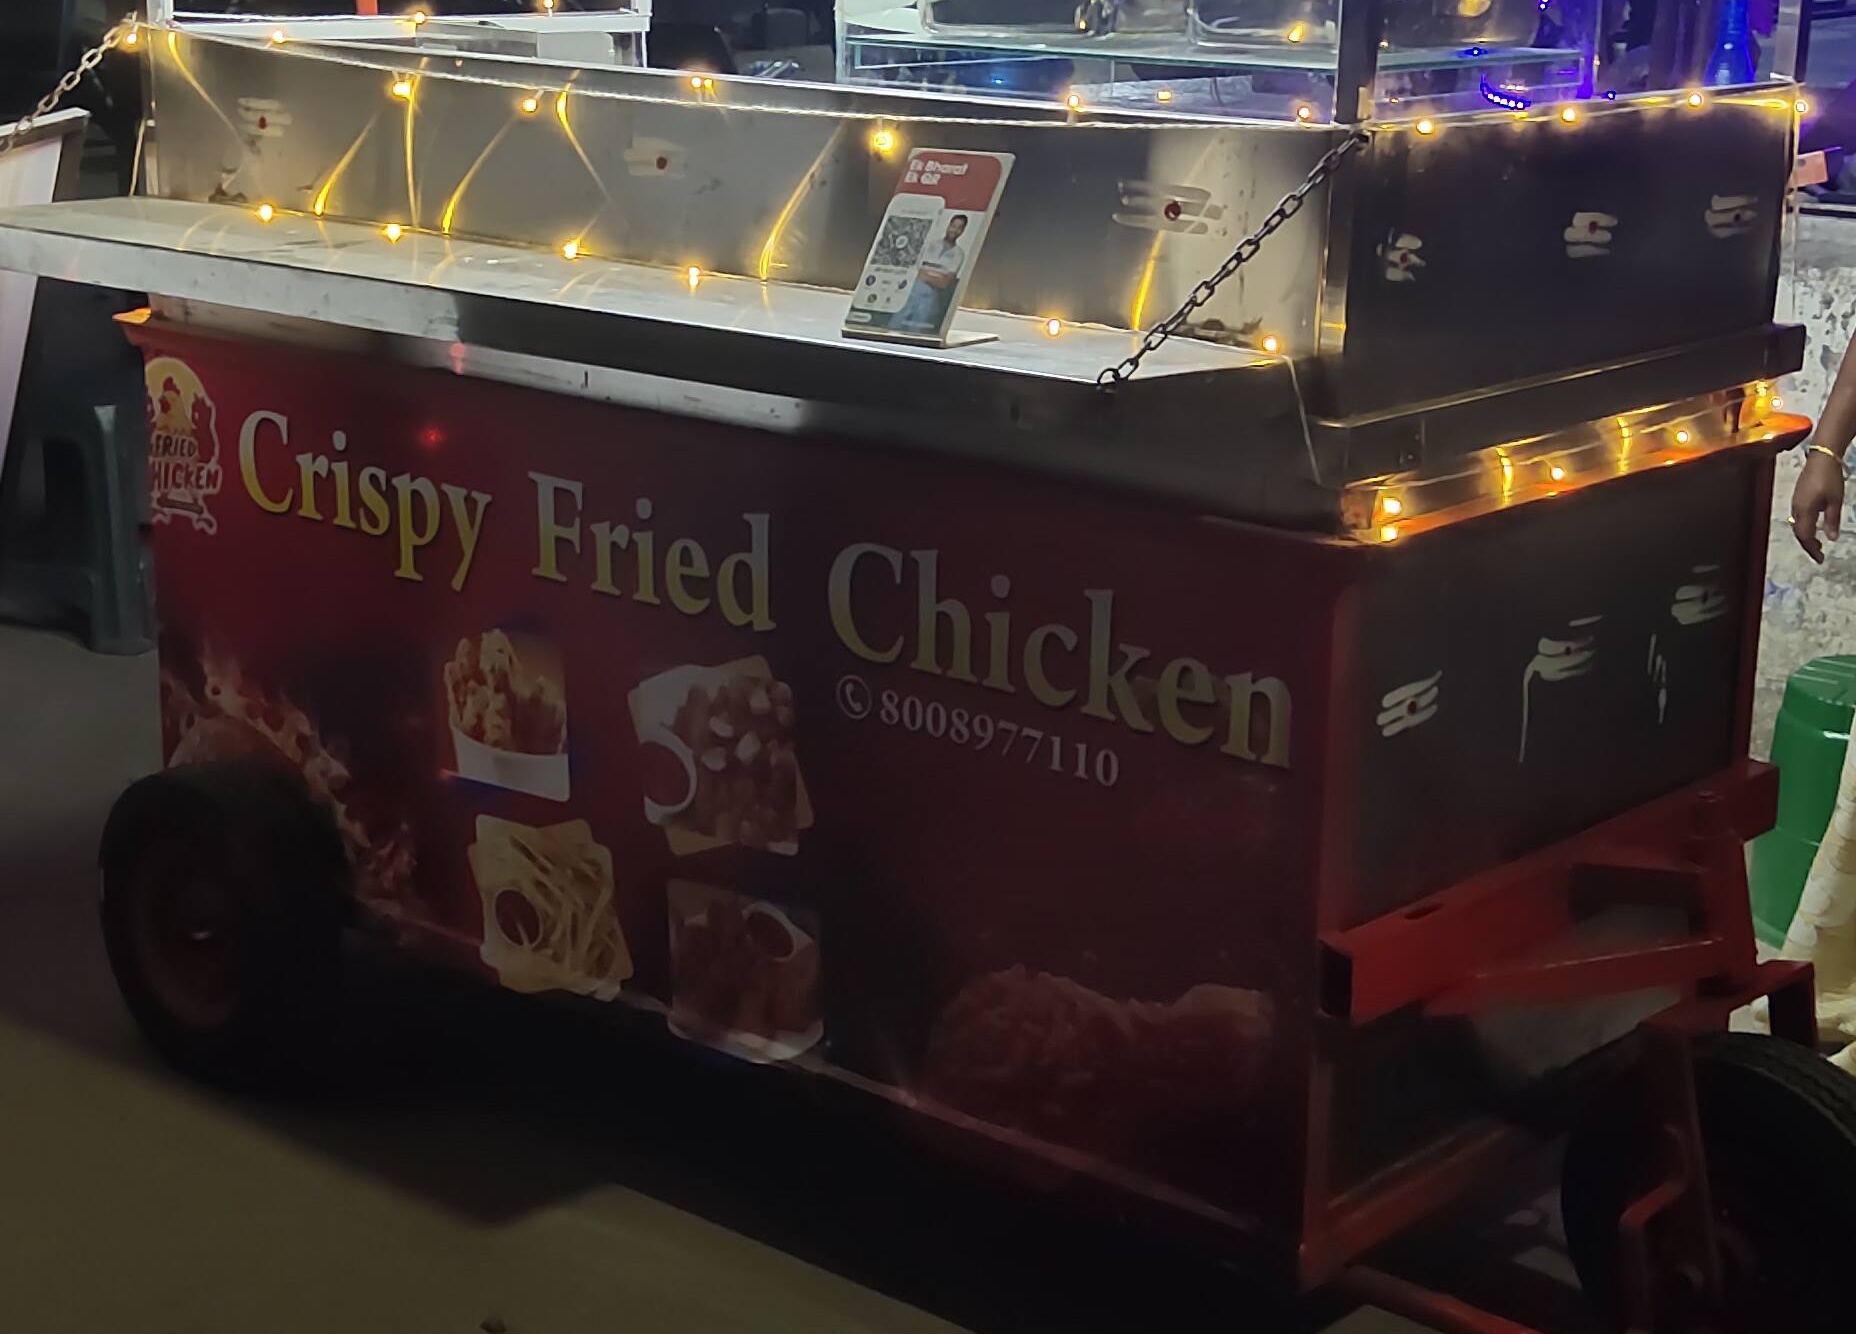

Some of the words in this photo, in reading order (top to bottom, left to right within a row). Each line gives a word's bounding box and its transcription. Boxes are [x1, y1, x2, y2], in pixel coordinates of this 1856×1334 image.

[151, 461, 219, 490] HICKEN
[154, 434, 197, 457] FRIED
[238, 409, 493, 593] Crispy
[528, 470, 778, 633] Fried
[827, 541, 1293, 770] Chicken
[879, 687, 1121, 789] 8008977110
